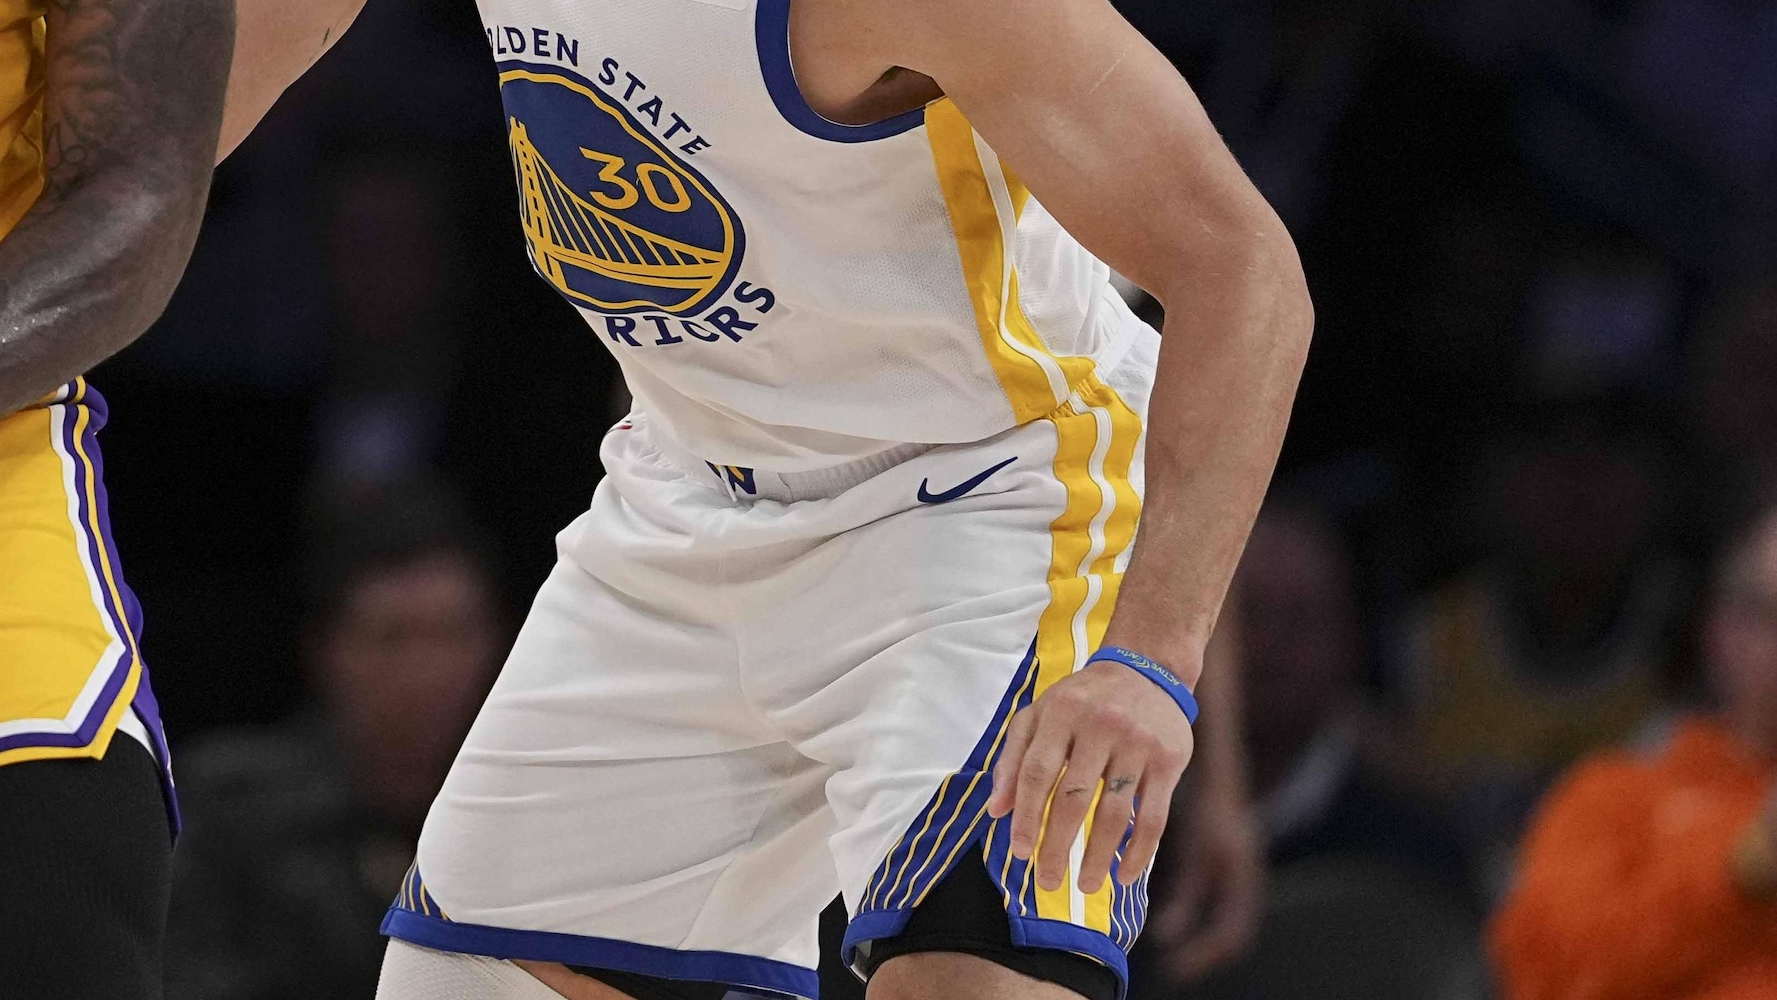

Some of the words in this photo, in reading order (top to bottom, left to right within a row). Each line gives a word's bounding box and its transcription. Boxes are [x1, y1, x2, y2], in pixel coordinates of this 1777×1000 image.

[487, 25, 579, 67] LDEN
[598, 57, 712, 156] STATE
[579, 147, 692, 213] 30
[602, 281, 775, 347] RIORS
[1150, 662, 1180, 686] ACTIVE
